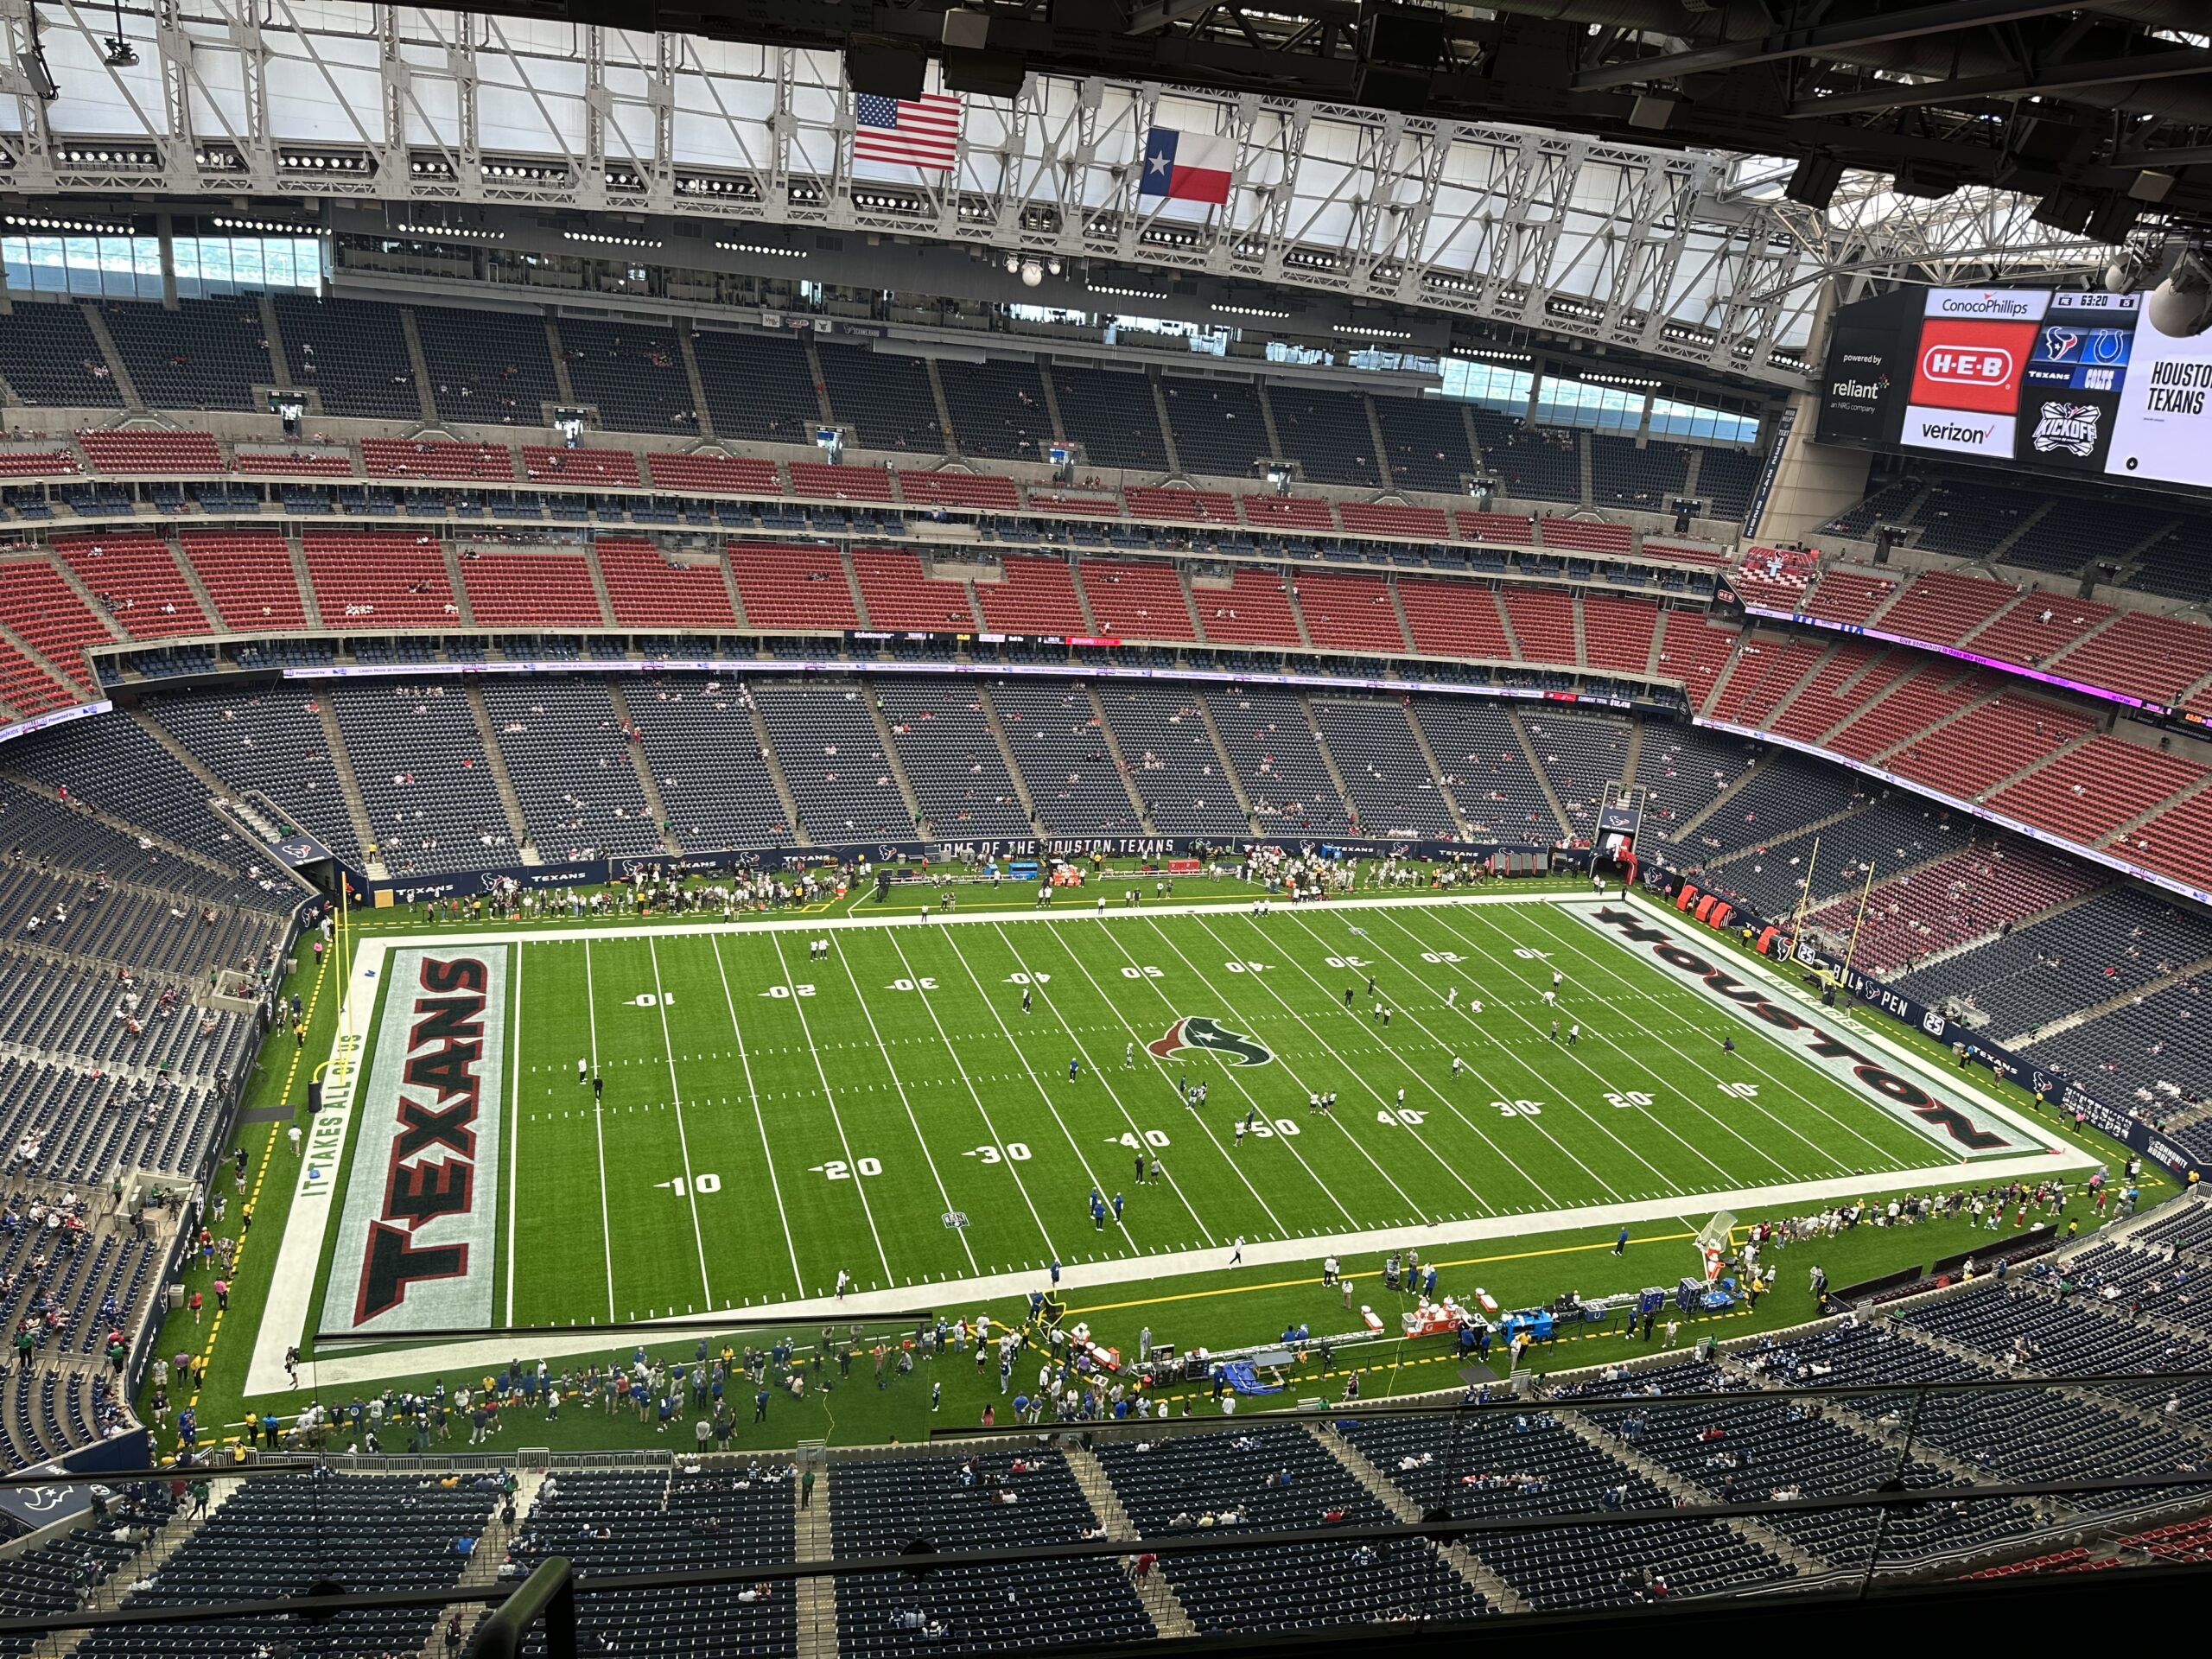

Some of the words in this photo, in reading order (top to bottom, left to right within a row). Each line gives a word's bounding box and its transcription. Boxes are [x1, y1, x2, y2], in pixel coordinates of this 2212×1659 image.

[1942, 298, 2028, 317] ConocoPhillips
[2081, 295, 2108, 307] 63:20
[1843, 353, 1872, 364] powered
[1872, 355, 1882, 365] by
[2028, 371, 2069, 380] TEXANS
[2084, 369, 2114, 390] COLTS
[2151, 361, 2212, 388] HOUSTO
[1833, 379, 1878, 399] reliant
[1837, 402, 1851, 410] NRG
[1851, 404, 1876, 414] company
[2147, 388, 2205, 415] TEXANS
[1922, 423, 1984, 444] verizon
[2035, 419, 2096, 442] KICKOFF
[1912, 641, 1942, 652] something
[1948, 649, 1962, 658] those
[48, 714, 69, 722] Presented
[982, 841, 1000, 853] OF
[1008, 841, 1035, 854] THE
[1119, 838, 1173, 853] TEXANS
[668, 861, 717, 870] TANS
[531, 872, 587, 883] TEXANS
[2157, 879, 2180, 891] Presented
[1325, 956, 1366, 968] 30
[1421, 951, 1463, 963] 20
[1512, 948, 1548, 959] 10
[1121, 966, 1165, 979] 50
[1224, 961, 1263, 973] 40
[893, 977, 940, 991] 30
[1010, 971, 1052, 984] 40
[635, 992, 676, 1007] 10
[768, 984, 817, 999] 20
[1763, 975, 1801, 995] END
[1805, 995, 1877, 1036] RACISM
[1881, 991, 1909, 1017] PEN
[1588, 906, 2012, 1150] HOUSTON
[1926, 1014, 1941, 1032] 25
[1973, 1046, 2018, 1075] TEXANS
[323, 1081, 352, 1109] ALL
[1717, 1082, 1759, 1098] 10
[1491, 1099, 1541, 1117] 30
[1603, 1090, 1653, 1109] 20
[1376, 1109, 1424, 1127] 40
[1249, 1119, 1301, 1138] 50
[308, 1117, 343, 1171] TAKES
[353, 956, 489, 1329] TEXANS
[1119, 1129, 1171, 1149] 40
[975, 1142, 1032, 1164] 30
[2146, 1146, 2172, 1166] HUDDLE
[2153, 1141, 2189, 1169] COMMUNITY
[823, 1157, 883, 1180] 20
[301, 1180, 329, 1197] IT
[671, 1173, 721, 1197] 10
[1426, 1323, 1433, 1332] G
[1448, 1320, 1456, 1329] G
